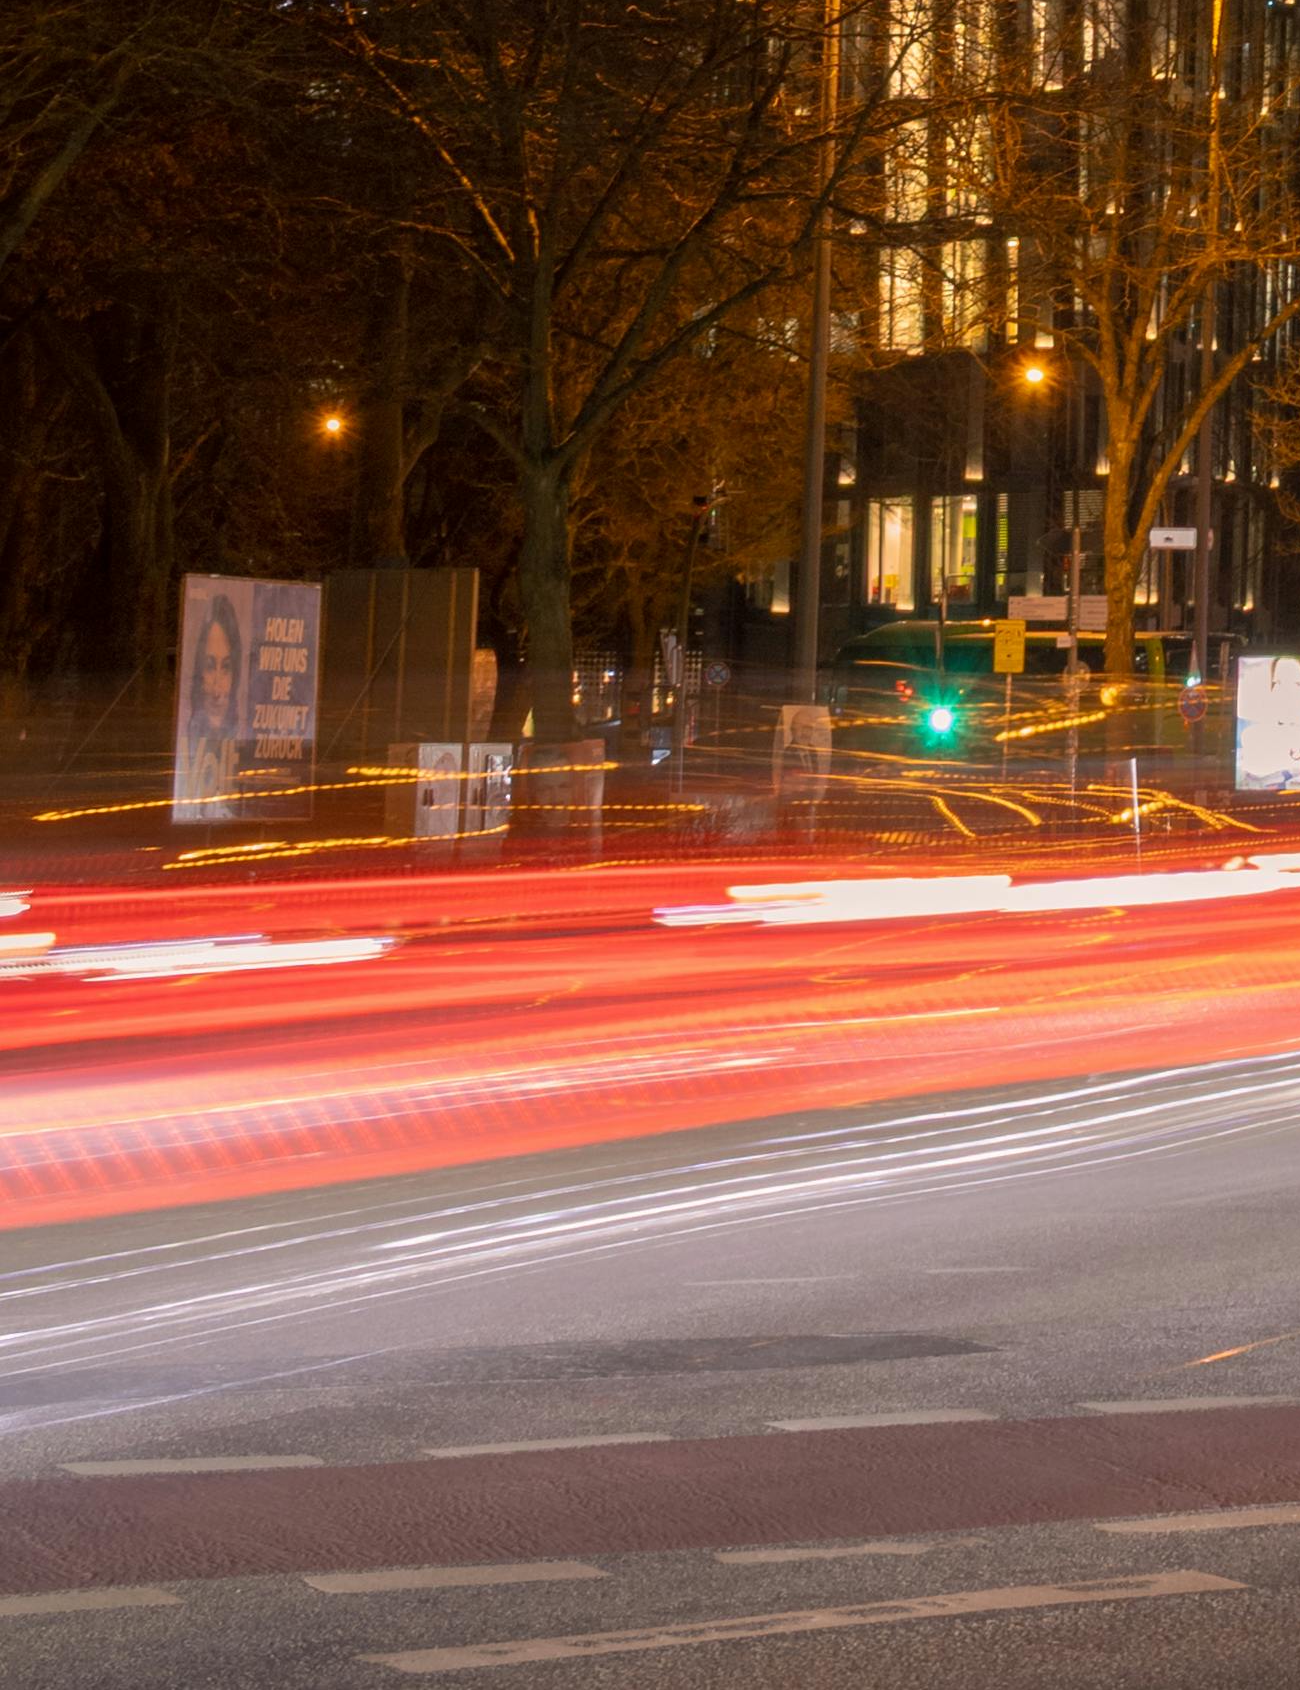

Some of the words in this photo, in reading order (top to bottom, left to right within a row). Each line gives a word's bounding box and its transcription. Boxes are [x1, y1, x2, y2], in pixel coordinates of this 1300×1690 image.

[265, 617, 304, 644] HOLEN
[259, 645, 282, 671] WIR
[283, 646, 308, 673] UNS
[271, 676, 292, 700] DIE
[252, 703, 308, 730] ZUKUNFT
[178, 736, 241, 798] Volt
